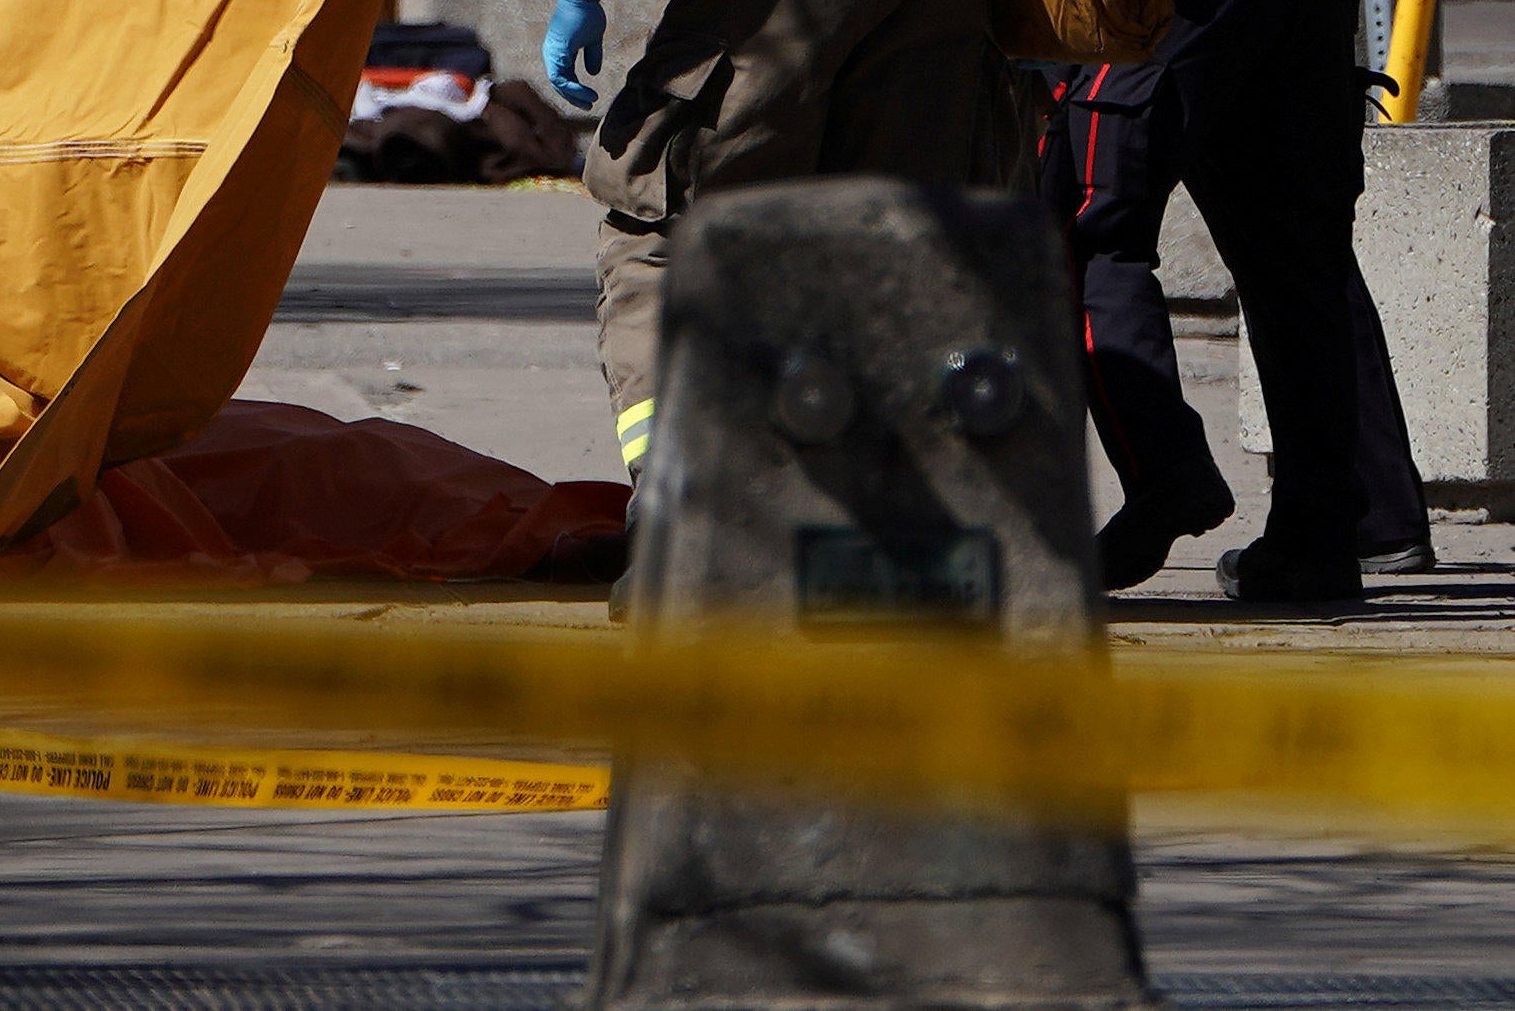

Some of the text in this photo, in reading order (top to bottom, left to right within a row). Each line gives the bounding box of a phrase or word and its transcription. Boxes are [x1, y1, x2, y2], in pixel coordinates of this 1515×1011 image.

[10, 765, 28, 781] NOT
[31, 766, 43, 783] DO
[75, 769, 111, 791] POLICE
[305, 786, 326, 800] NOT
